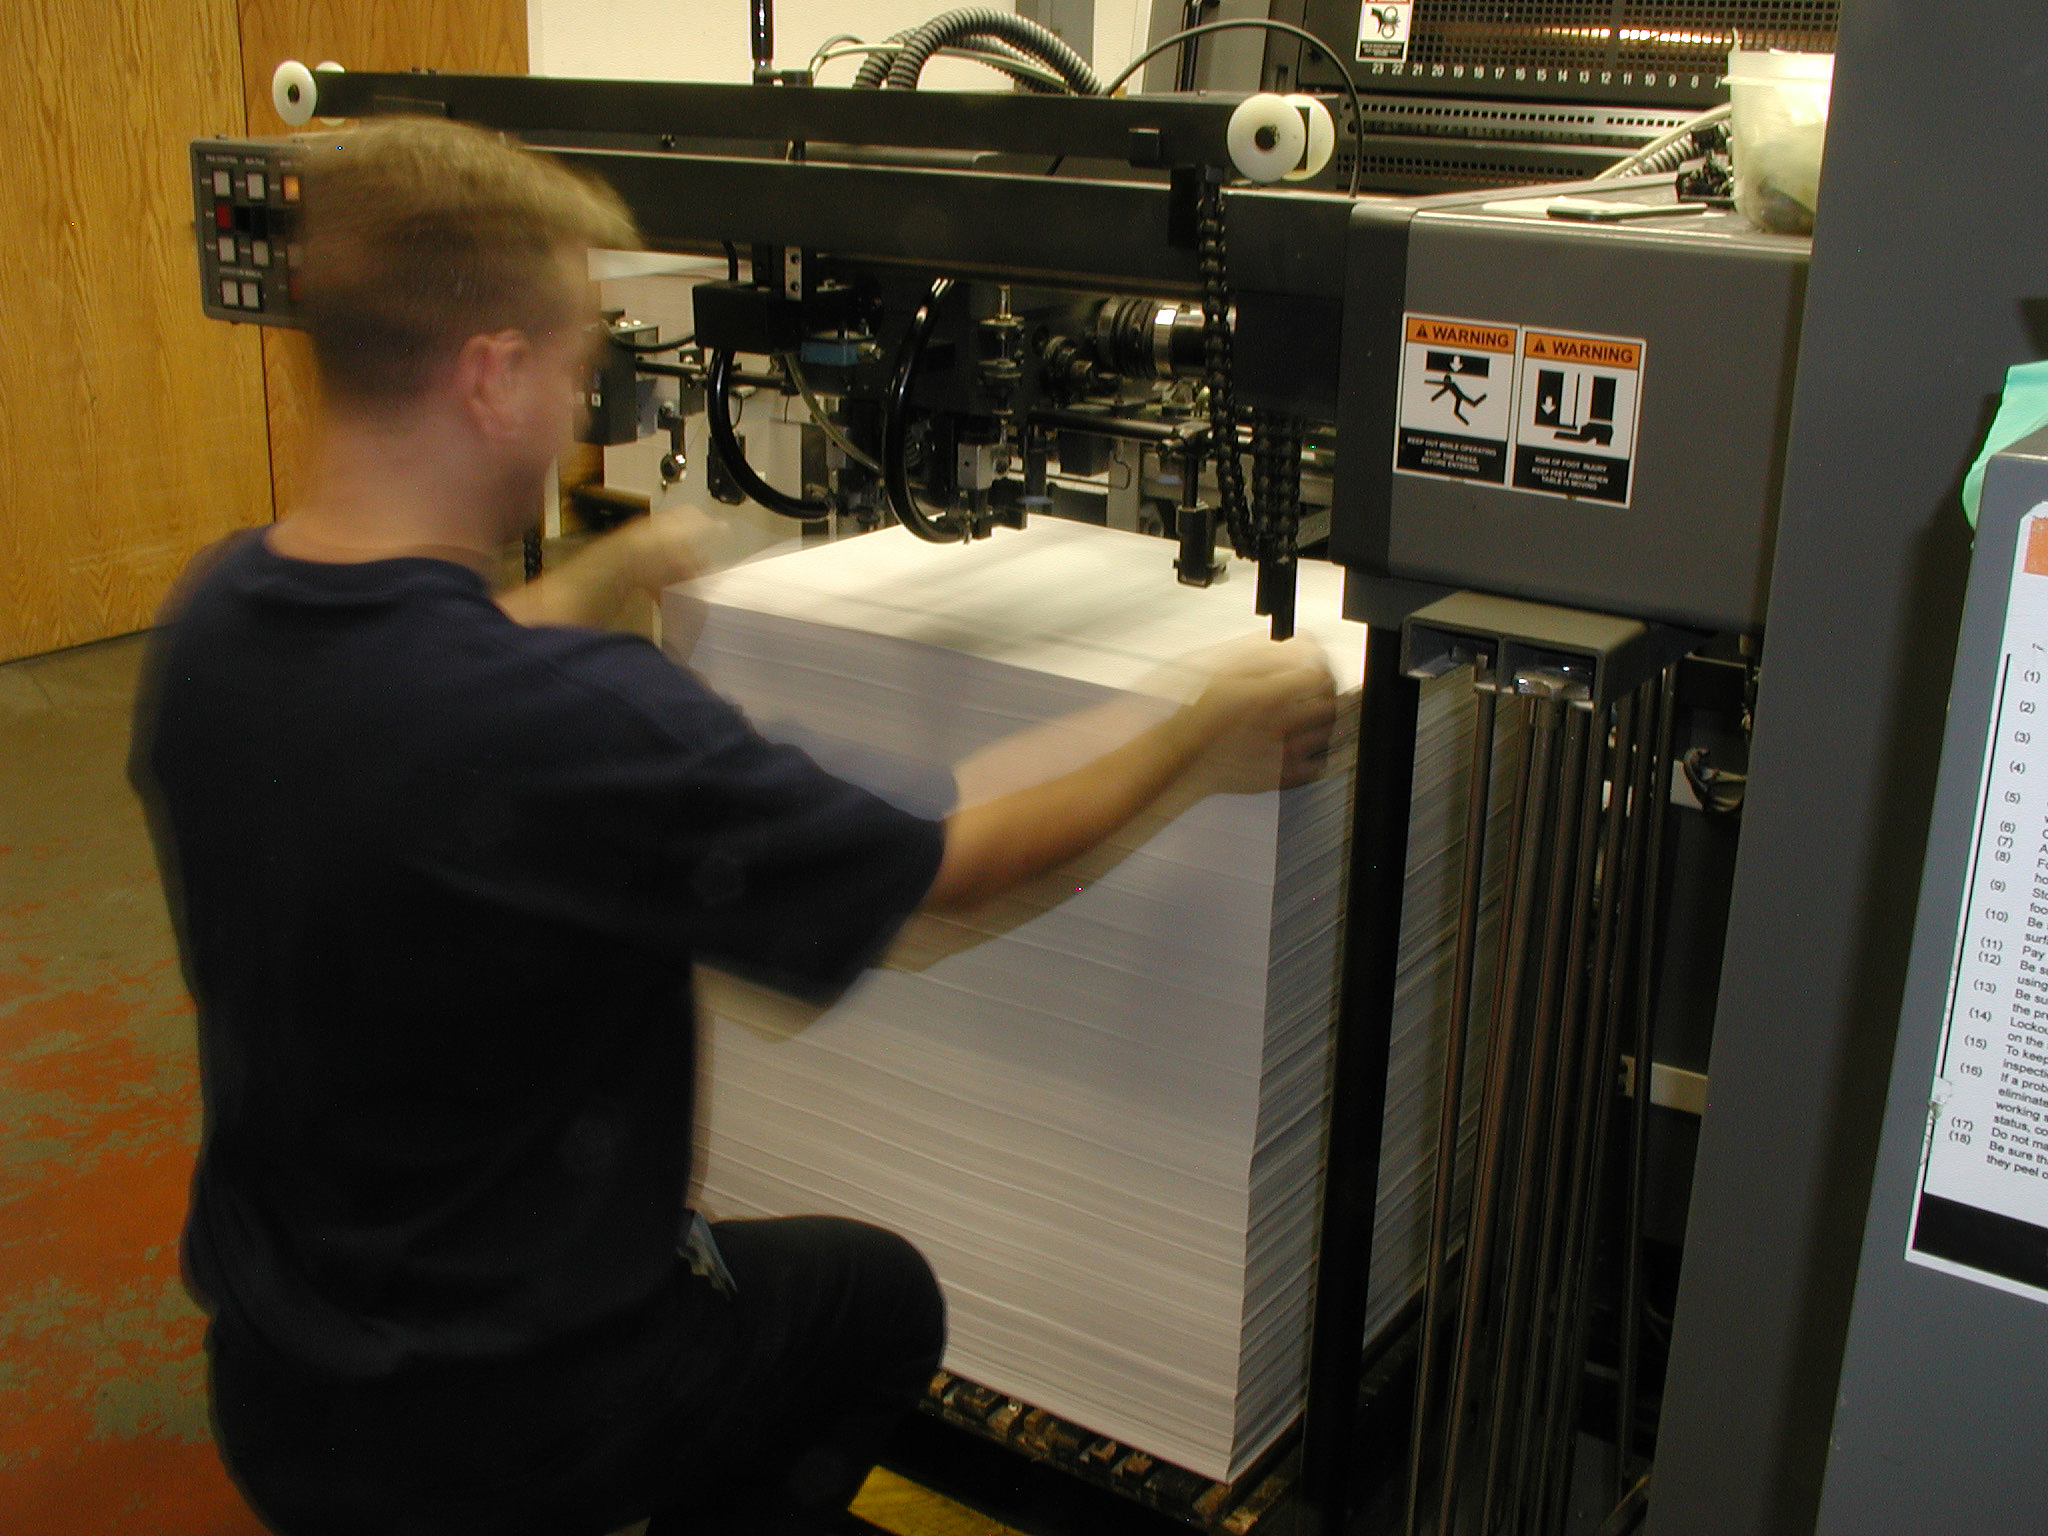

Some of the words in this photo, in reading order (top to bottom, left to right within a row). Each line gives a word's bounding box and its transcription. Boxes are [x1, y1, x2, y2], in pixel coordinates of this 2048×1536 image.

[1432, 64, 1445, 77] 20
[1601, 71, 1611, 84] 12
[1623, 71, 1633, 85] 11
[1645, 72, 1656, 87] 10
[1668, 73, 1677, 88] 9
[1690, 74, 1700, 89] 8
[1433, 325, 1509, 348] WARNING
[1552, 341, 1633, 363] WARNING
[2024, 670, 2041, 684] (1)
[2019, 700, 2035, 714] (2)
[2014, 730, 2031, 745] (3)
[2009, 760, 2026, 775] (4)
[2004, 790, 2021, 805] (5)
[2000, 820, 2016, 834] (6)
[1997, 835, 2013, 849] (7)
[1995, 850, 2011, 863] (8)
[1990, 879, 2006, 893] (9)
[1985, 907, 2009, 923] (10)
[2027, 917, 2043, 929] Be
[2024, 933, 2048, 946] surf
[1980, 936, 2003, 952] (11)
[2022, 945, 2046, 962] Pay
[1978, 951, 2001, 966] (12)
[2019, 960, 2036, 972] Be
[1973, 979, 1996, 994] (13)
[2014, 988, 2031, 1001] Be
[2016, 976, 2048, 992] using
[1969, 1007, 1992, 1022] (14)
[2012, 1003, 2031, 1016] the
[2007, 1033, 2022, 1043] on
[2025, 1035, 2044, 1048] the
[1964, 1034, 1987, 1050] (15)
[2005, 1044, 2019, 1056] To
[2022, 1049, 2048, 1065] keep
[1960, 1062, 1982, 1077] (16)
[2000, 1072, 2010, 1082] If
[2011, 1077, 2019, 1085] a
[2021, 1079, 2048, 1093] prob
[1995, 1101, 2040, 1122] working
[1951, 1116, 1974, 1132] (17)
[1991, 1127, 2008, 1140] Do
[2010, 1134, 2029, 1146] not
[1993, 1115, 2031, 1133] status,
[1949, 1130, 1971, 1145] (18)
[1989, 1140, 2005, 1153] Be
[2008, 1148, 2033, 1161] sure
[2036, 1154, 2048, 1166] th
[1986, 1155, 2011, 1170] they
[2014, 1163, 2039, 1177] peel
